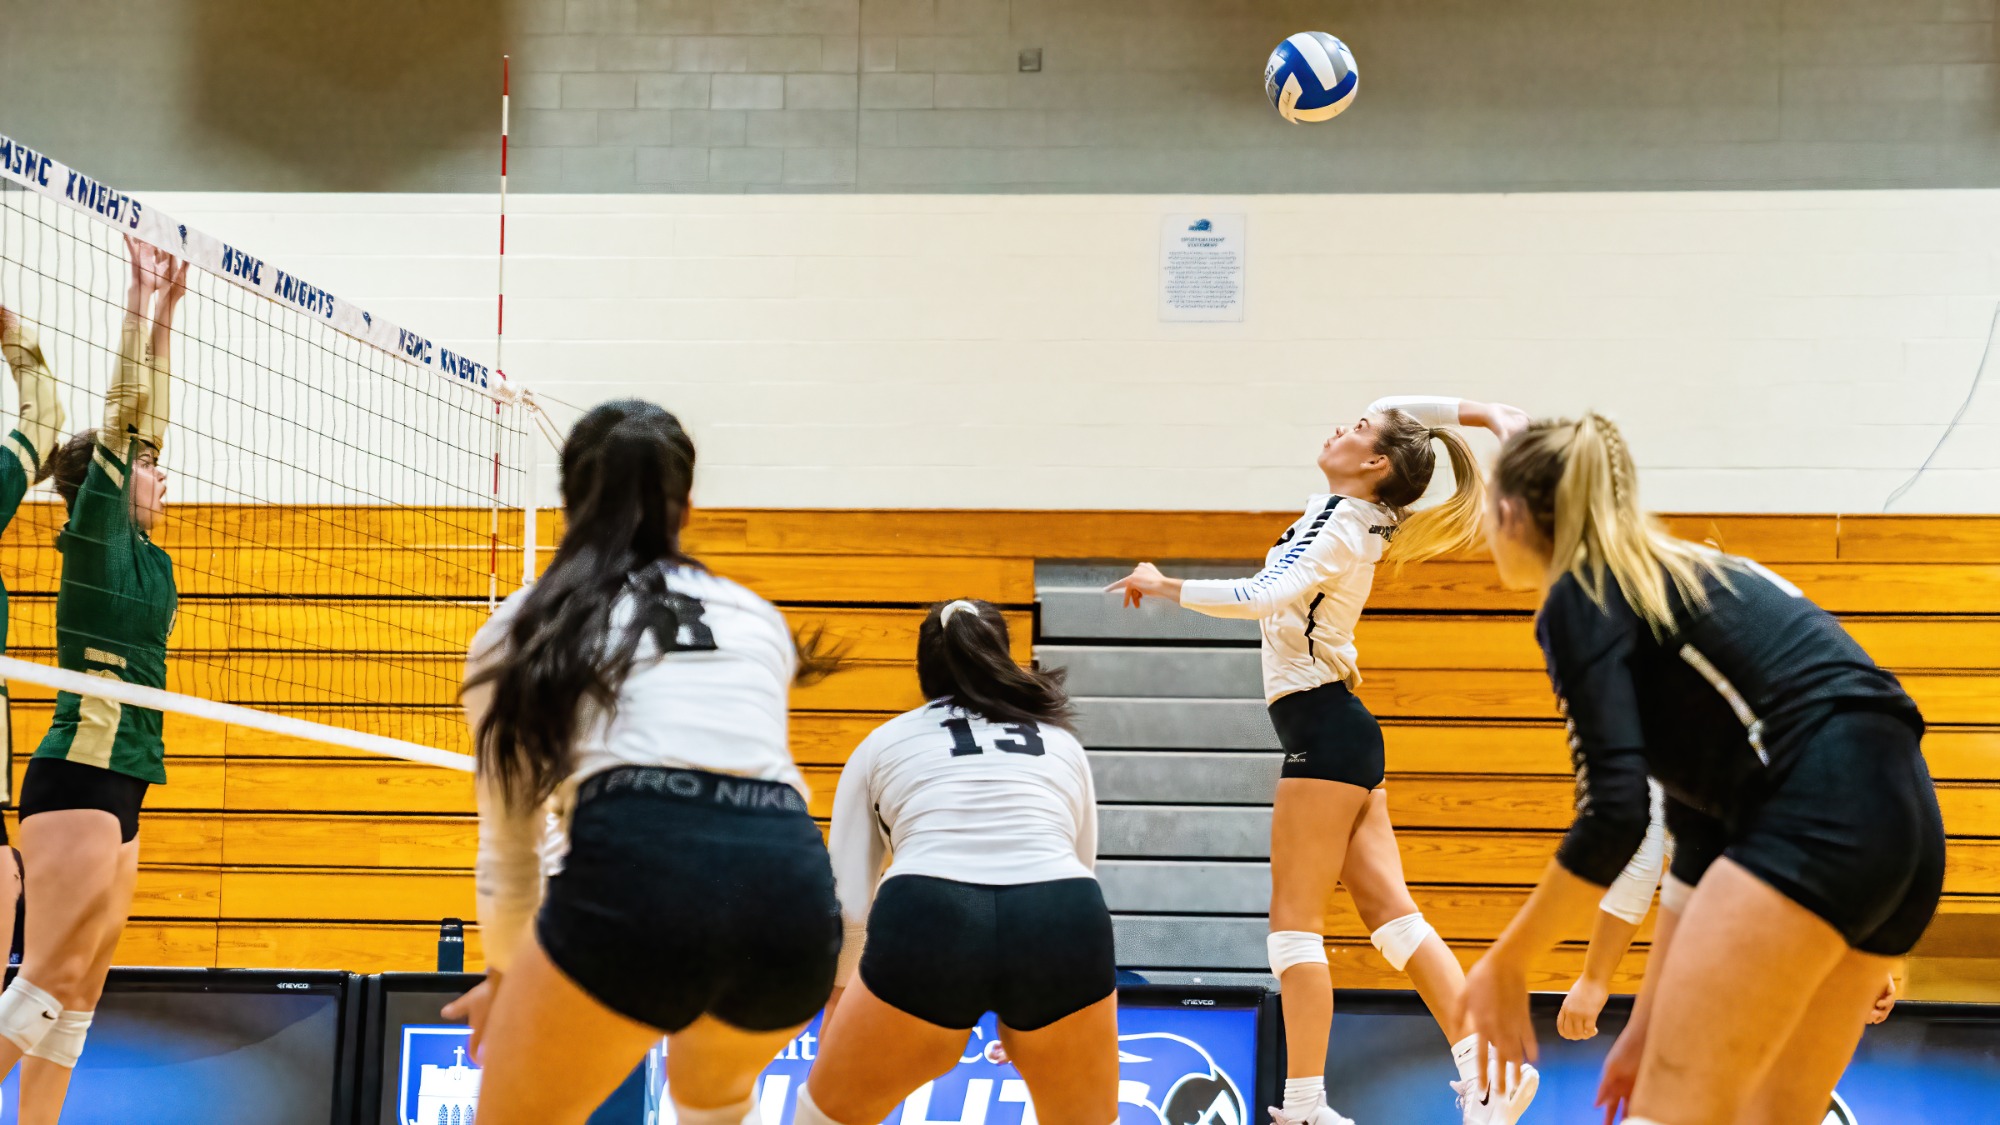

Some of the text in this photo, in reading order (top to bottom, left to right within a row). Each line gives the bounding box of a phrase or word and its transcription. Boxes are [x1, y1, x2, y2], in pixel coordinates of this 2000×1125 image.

[66, 170, 142, 229] KNIGHTS
[275, 268, 335, 318] KNIGHTS
[441, 347, 488, 388] KNIGHTS
[939, 718, 1046, 757] 13
[606, 769, 700, 797] PRO
[715, 781, 808, 814] NIKE
